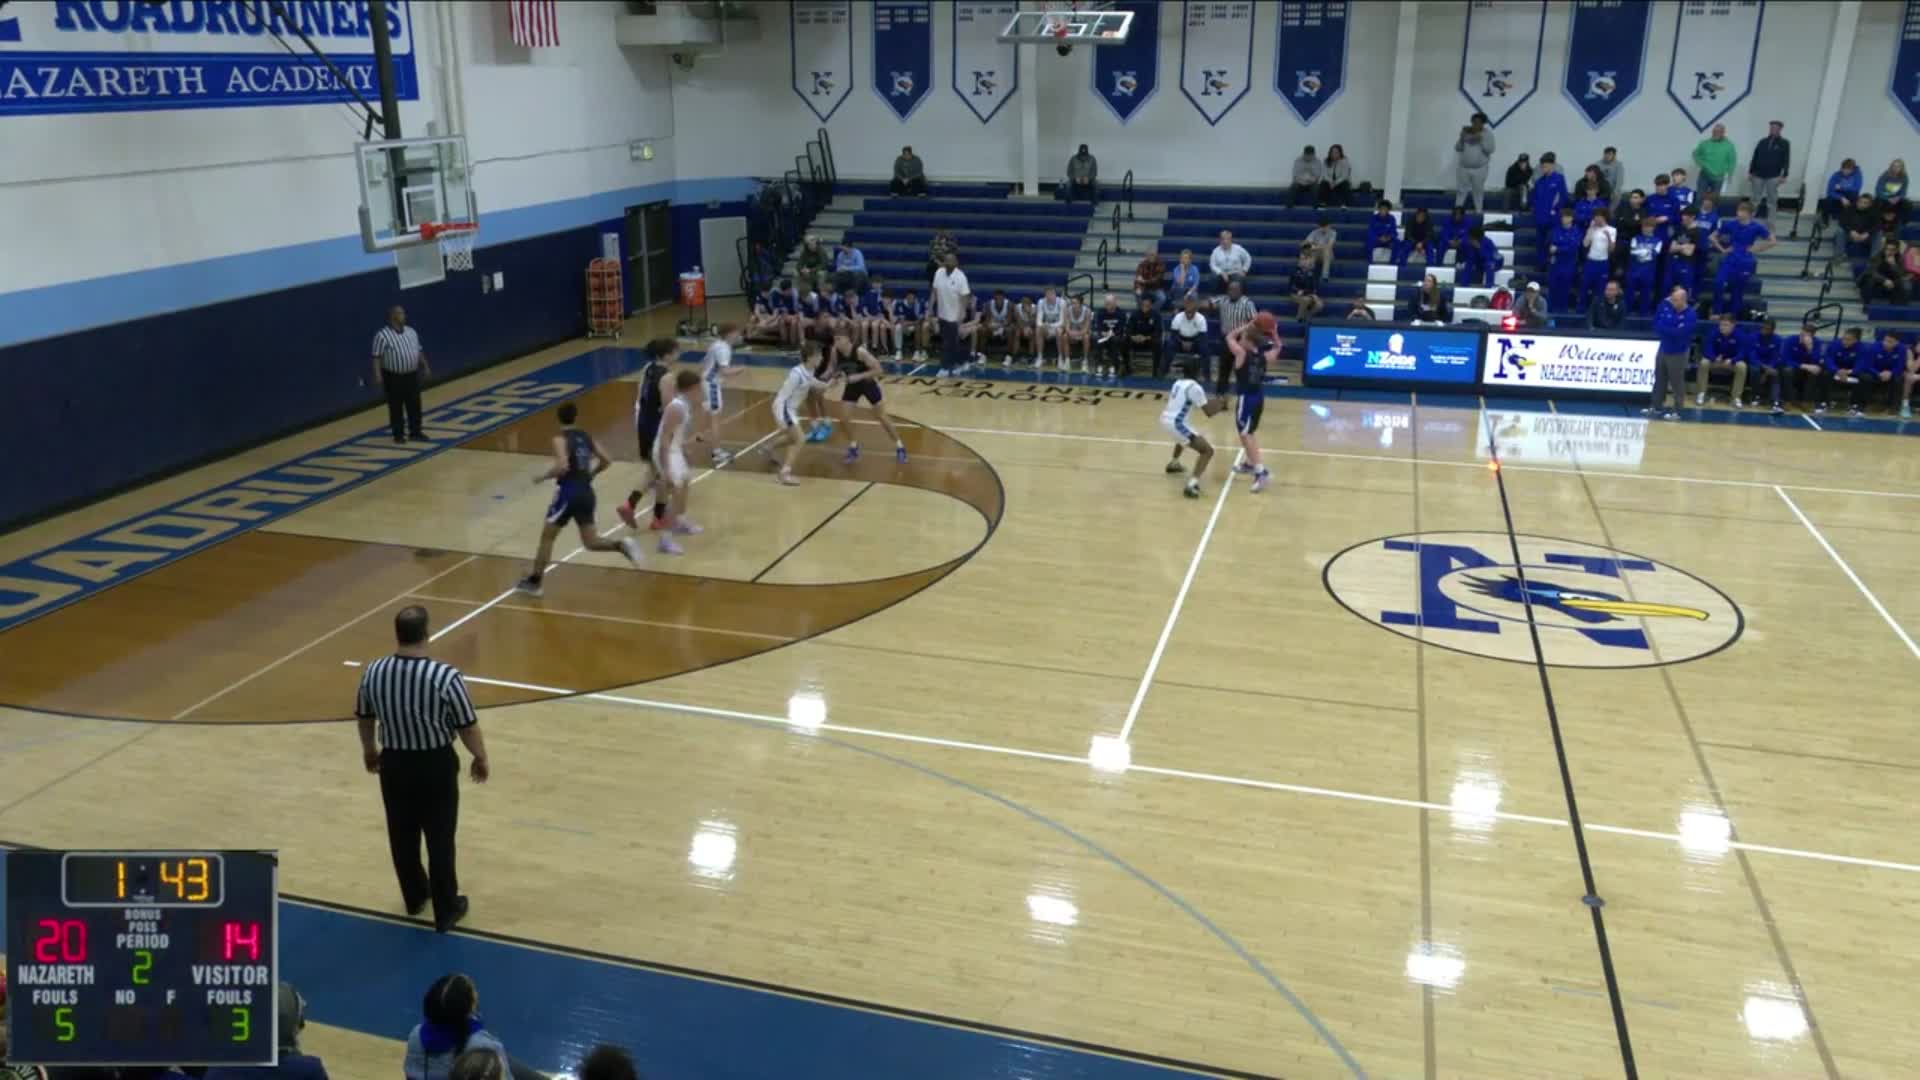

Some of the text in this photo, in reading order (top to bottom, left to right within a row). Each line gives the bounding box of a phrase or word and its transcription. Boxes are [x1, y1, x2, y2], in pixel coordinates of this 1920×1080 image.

[0, 65, 373, 98] AZARETH ACADEMY
[1367, 350, 1417, 366] NZone
[1558, 343, 1644, 362] Welcome to
[1540, 364, 1656, 386] NAZARETH ACADEMY
[1015, 384, 1165, 400] UDENT
